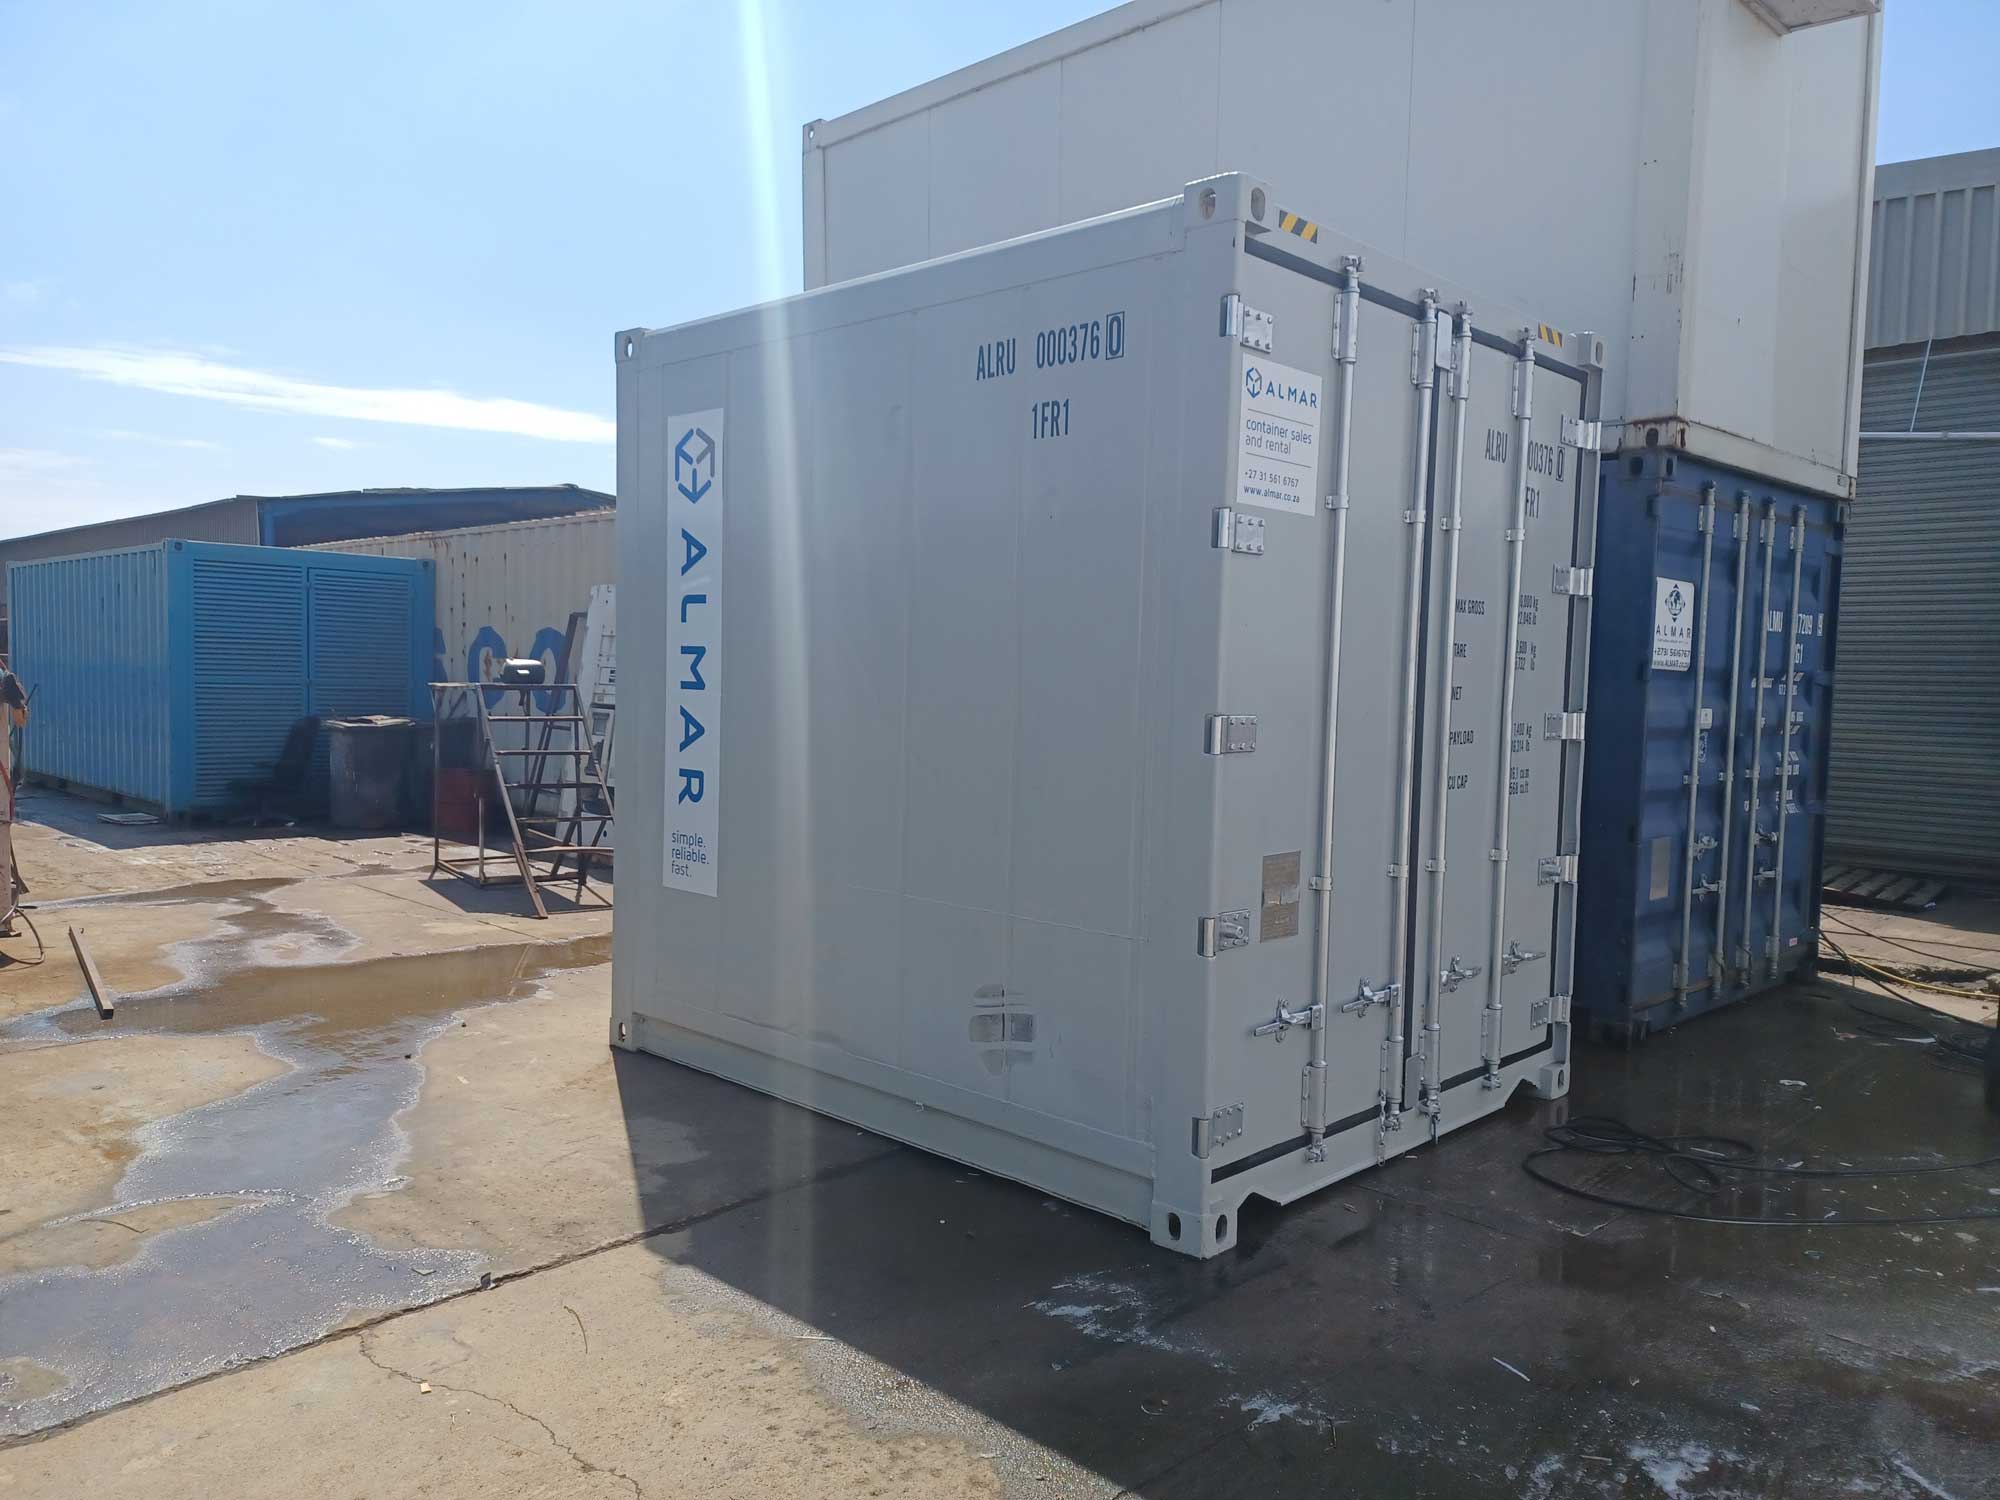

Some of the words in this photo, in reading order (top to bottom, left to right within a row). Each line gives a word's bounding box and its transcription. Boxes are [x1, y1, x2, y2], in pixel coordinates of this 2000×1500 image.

[976, 338, 1016, 381] ALRU
[1036, 320, 1100, 369] 000376
[1107, 313, 1123, 357] 0
[1265, 381, 1318, 409] ALMAR
[1031, 398, 1069, 439] 1FR1
[1246, 418, 1289, 439] container
[1291, 429, 1312, 445] sales
[1245, 434, 1262, 449] and
[1265, 438, 1291, 455] rental
[1484, 428, 1508, 463] ALRU
[1527, 440, 1553, 476] 00376
[1244, 469, 1257, 481] +27
[1259, 471, 1267, 482] 31
[1269, 473, 1281, 486] 561
[1283, 475, 1299, 488] 6767
[1244, 485, 1301, 504] www.almar.co.za
[1525, 486, 1540, 519] FR1
[1467, 599, 1485, 616] GROSS
[1655, 624, 1692, 639] ALMAR
[1454, 642, 1467, 658] TARE
[678, 527, 708, 805] ALMAR
[1449, 729, 1474, 745] PAYLOAD
[1448, 775, 1456, 790] CU
[1456, 774, 1468, 789] CAP
[671, 830, 707, 849] simple.
[671, 846, 710, 865] reliable.
[671, 860, 693, 878] fast.
